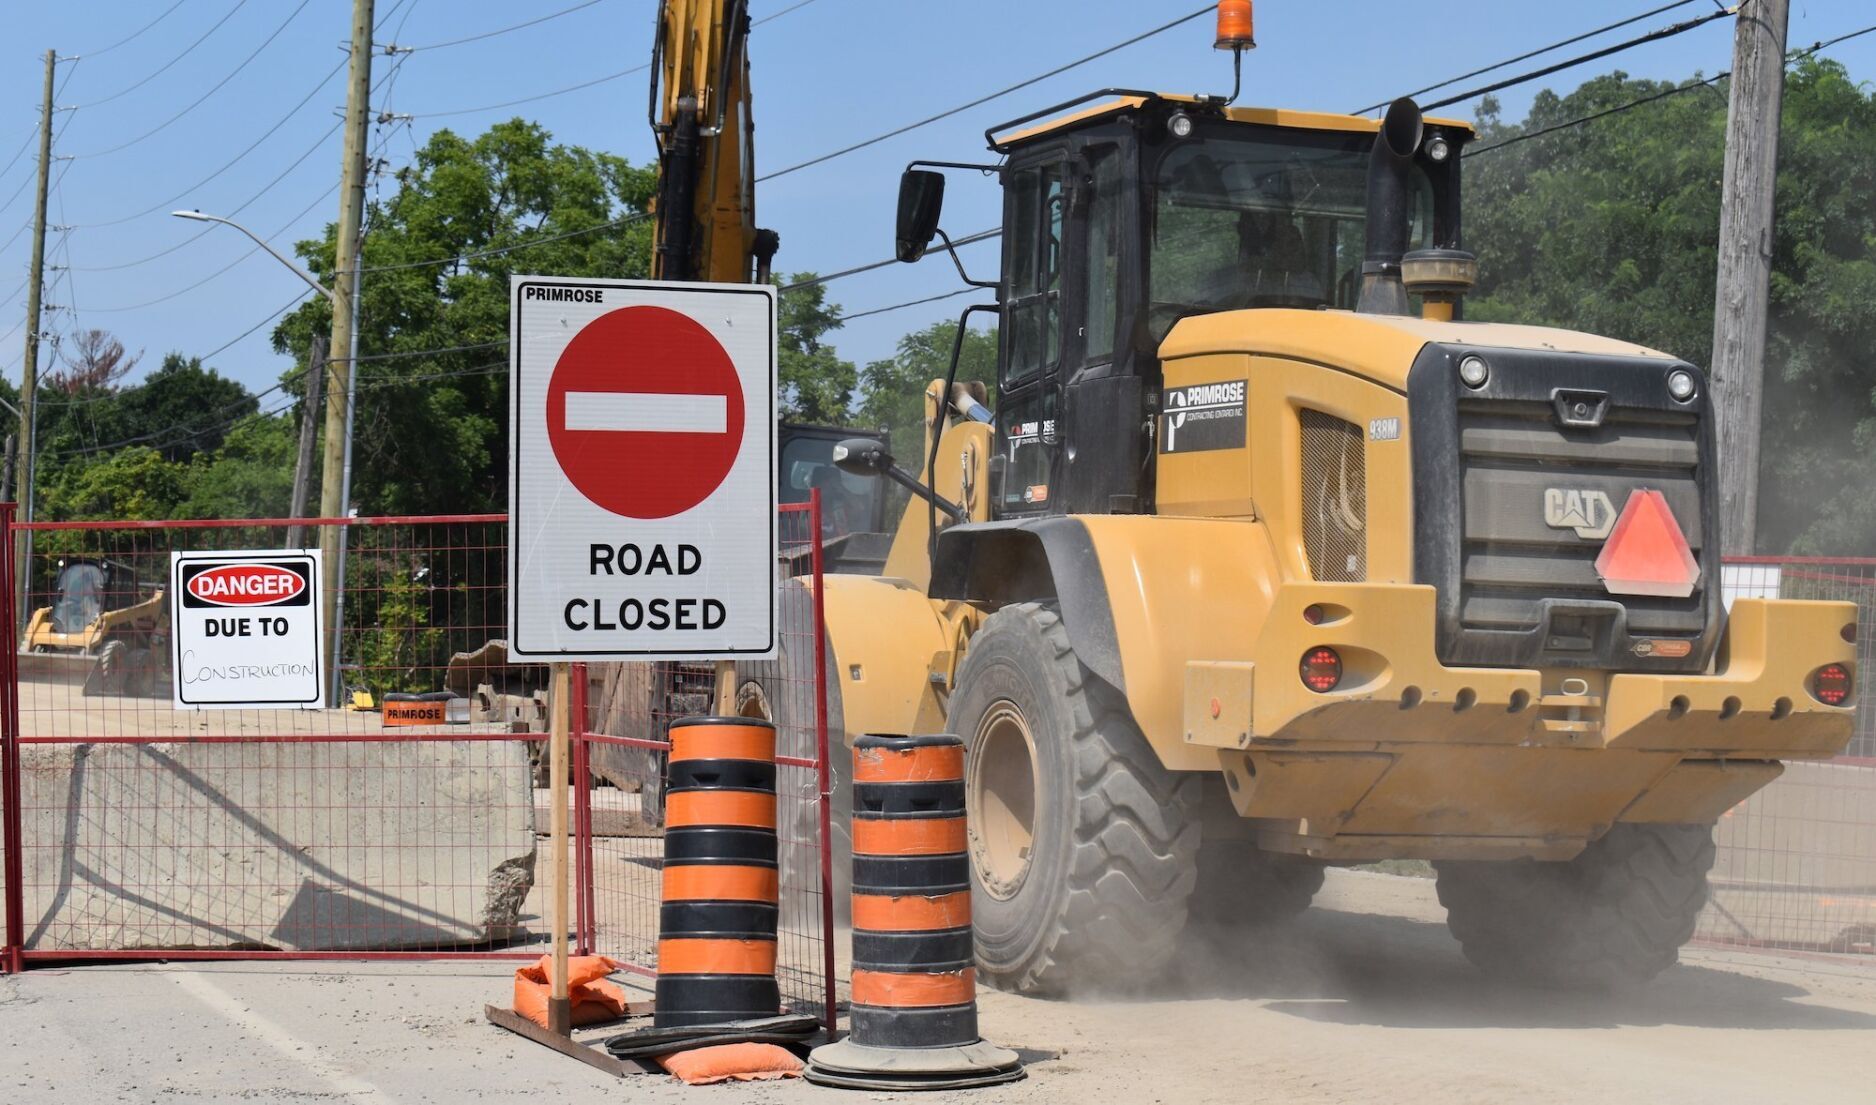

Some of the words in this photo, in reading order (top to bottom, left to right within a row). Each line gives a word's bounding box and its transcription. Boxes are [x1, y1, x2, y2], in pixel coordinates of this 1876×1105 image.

[526, 287, 603, 303] PRIMROSE
[1187, 381, 1244, 406] PRIMROSE
[1370, 418, 1398, 440] 938M
[1544, 488, 1603, 528] CAT
[590, 543, 702, 575] ROAD
[197, 574, 294, 596] DANGER
[564, 598, 727, 631] CLOSED
[205, 618, 251, 637] DUE
[258, 617, 289, 636] TO
[182, 650, 314, 684] CONSTRUCTION
[387, 709, 440, 720] PRIMROSE
